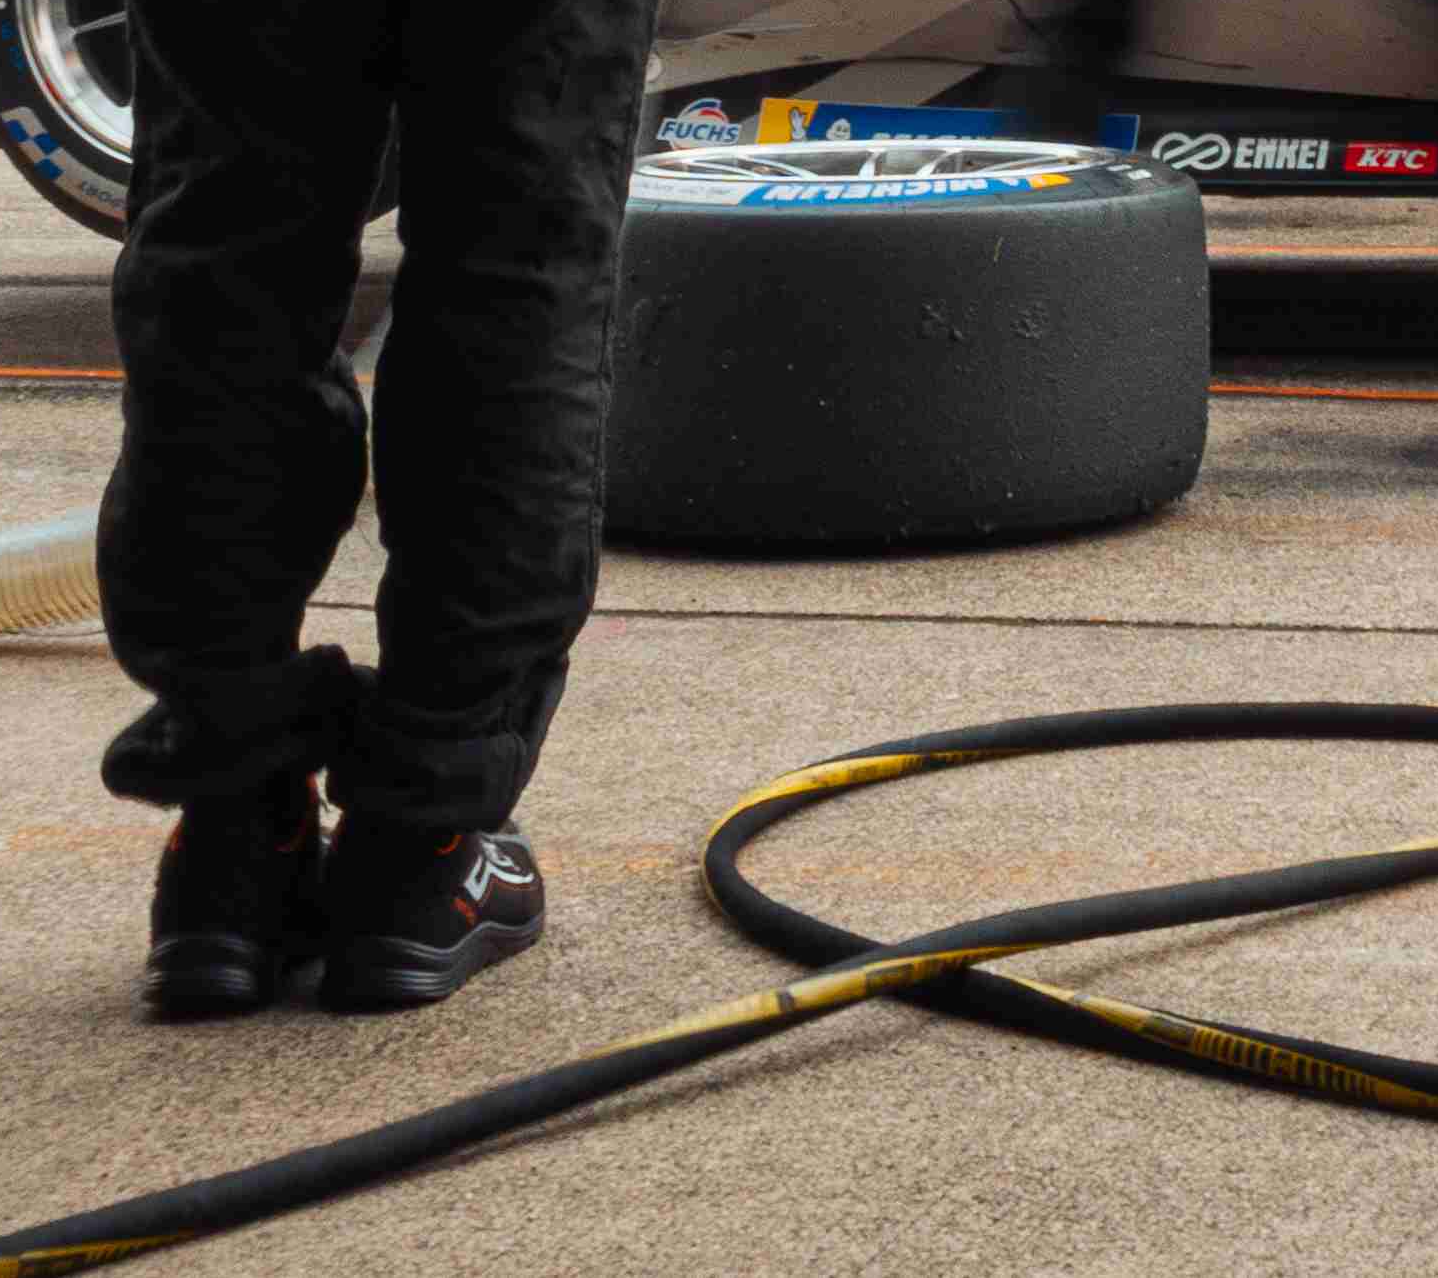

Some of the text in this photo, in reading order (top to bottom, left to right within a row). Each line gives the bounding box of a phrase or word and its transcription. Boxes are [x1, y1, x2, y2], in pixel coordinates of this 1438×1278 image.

[662, 120, 740, 144] FUCHS
[1233, 137, 1330, 171] ENKEI
[1356, 147, 1429, 171] KTC
[762, 178, 989, 202] MICHELIN
